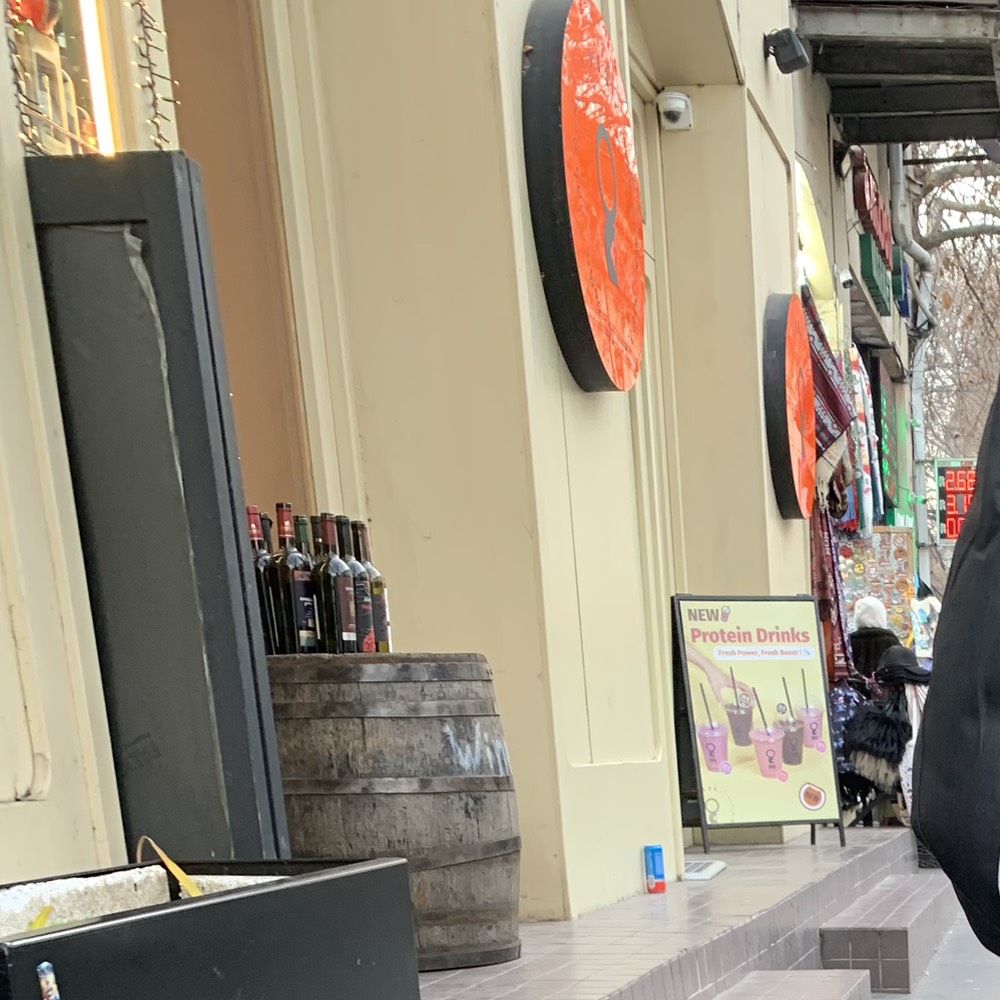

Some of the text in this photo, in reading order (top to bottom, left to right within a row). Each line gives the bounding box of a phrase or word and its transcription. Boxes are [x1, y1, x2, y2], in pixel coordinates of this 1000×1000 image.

[687, 608, 720, 622] NEW
[690, 625, 811, 644] Protein Drinks
